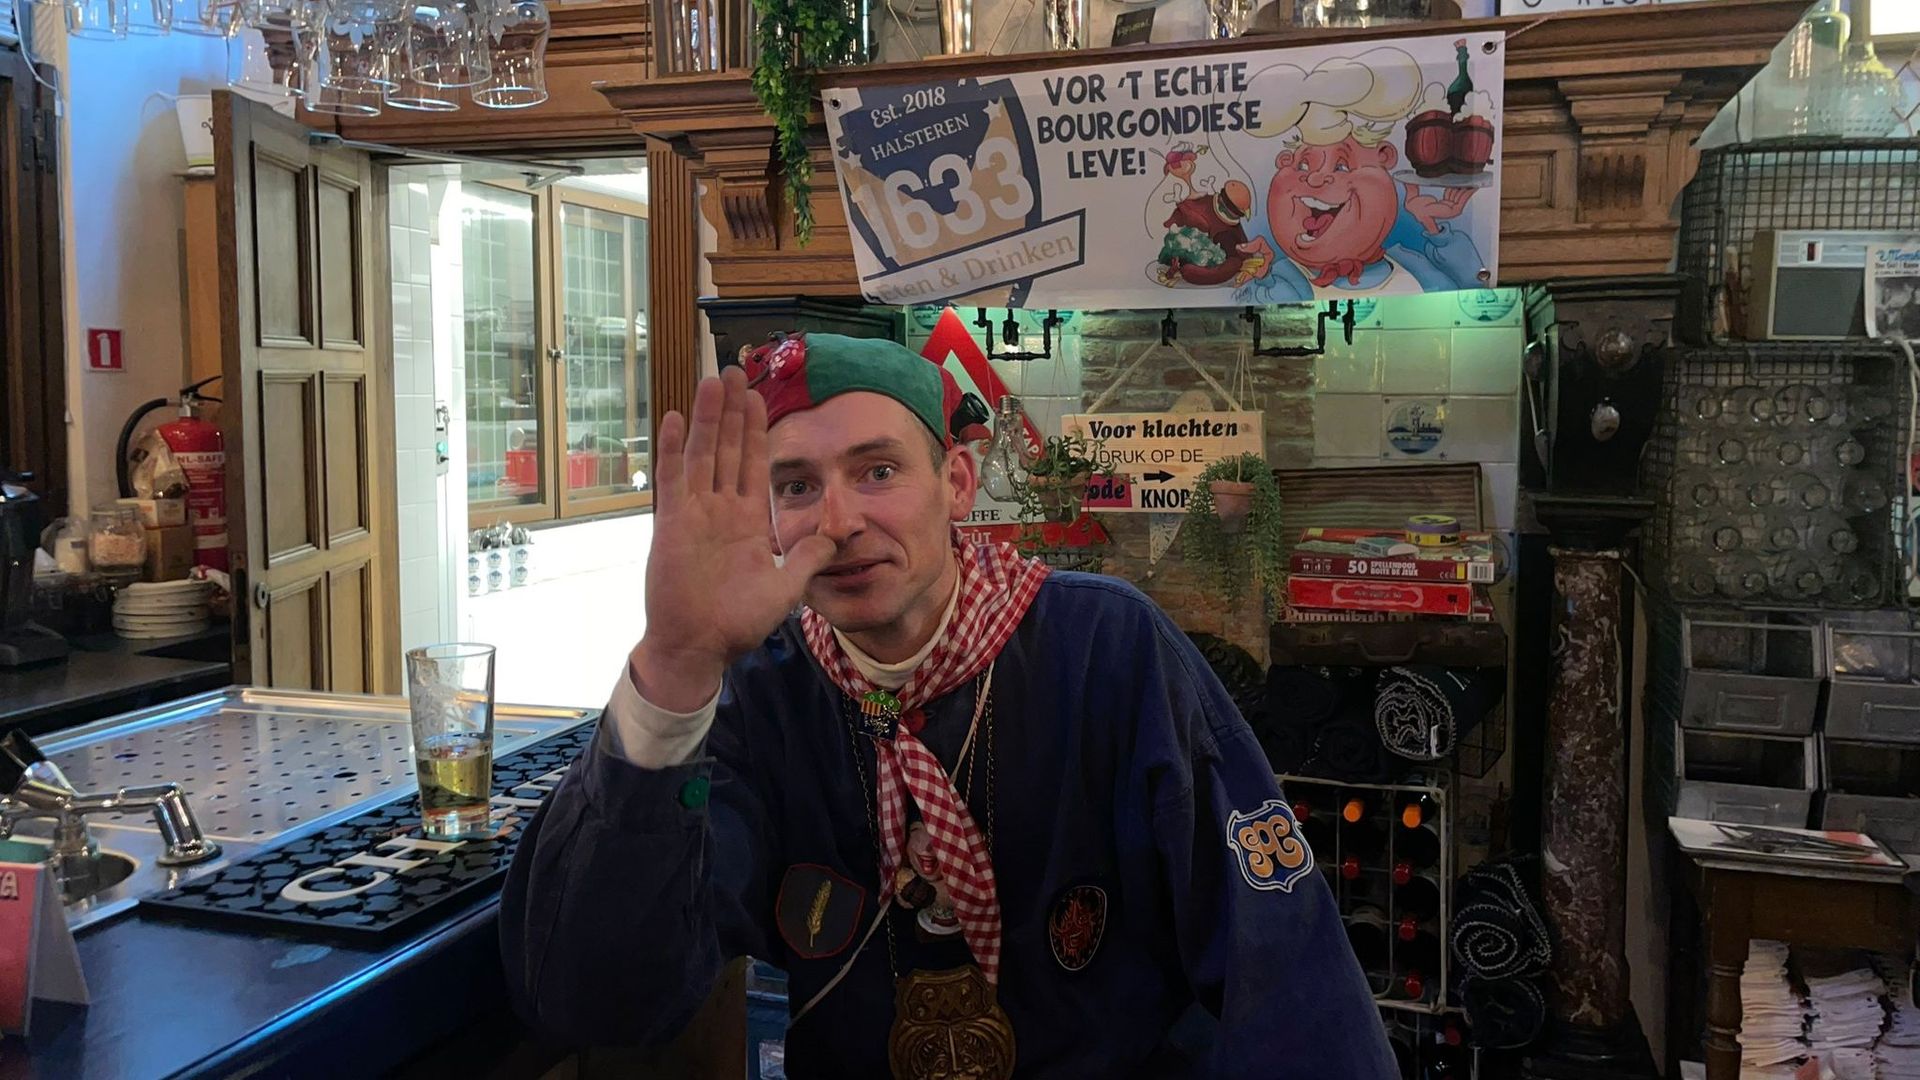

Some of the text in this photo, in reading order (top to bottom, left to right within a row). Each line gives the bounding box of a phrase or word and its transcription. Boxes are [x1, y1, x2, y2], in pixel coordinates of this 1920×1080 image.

[1043, 61, 1248, 106] VOR 'T ECHTE
[870, 86, 946, 129] Est. 2018
[1037, 100, 1262, 144] BOURGONDIESE
[870, 113, 970, 161] HALSTEREN
[1067, 148, 1146, 179] LEVE!
[850, 136, 1034, 260] 1633
[938, 266, 960, 288] &
[963, 233, 1075, 281] Drinken
[1089, 417, 1239, 438] Voor klachten
[1100, 448, 1204, 463] DRUK OP DE
[1085, 479, 1126, 499] ode
[1347, 560, 1368, 575] 50
